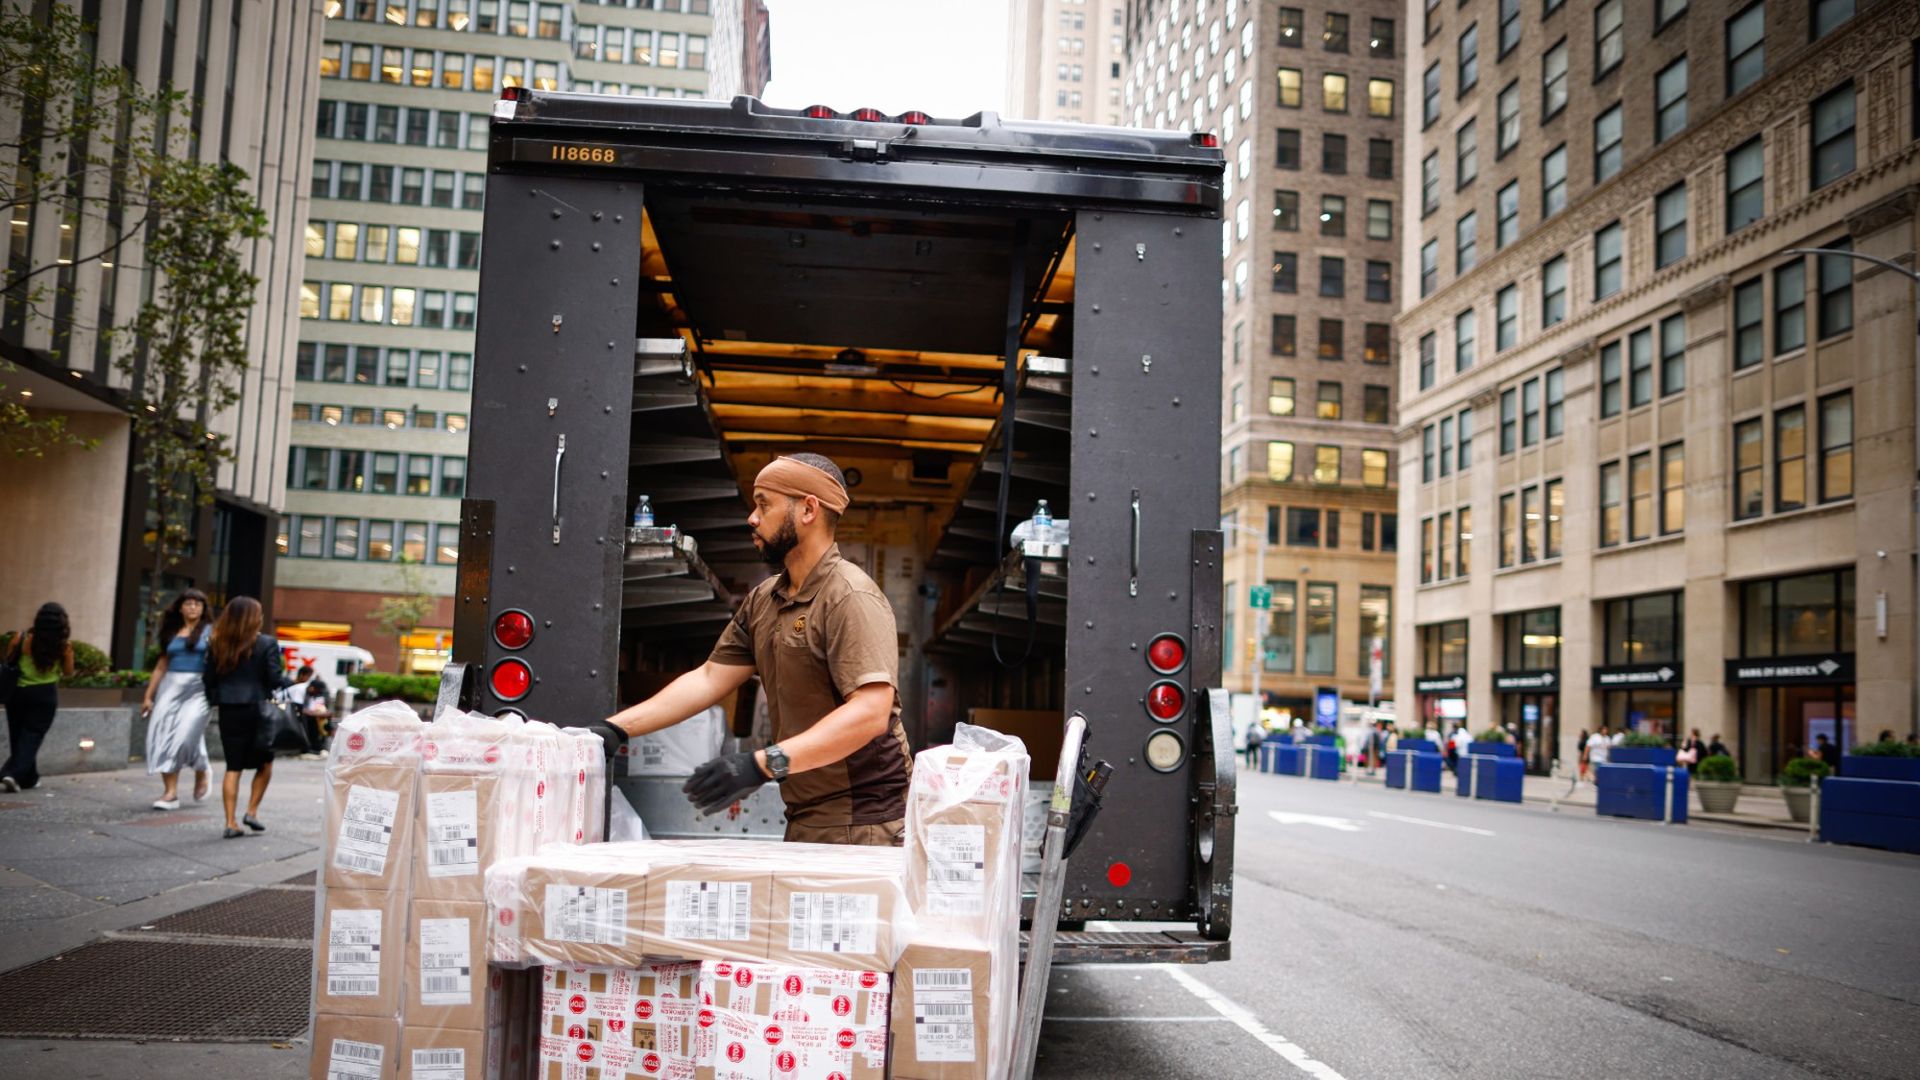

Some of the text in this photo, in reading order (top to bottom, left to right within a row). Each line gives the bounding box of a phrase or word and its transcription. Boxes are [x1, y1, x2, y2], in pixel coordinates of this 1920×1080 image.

[552, 145, 615, 163] 118668
[790, 976, 798, 994] STOP
[571, 1000, 585, 1008] STOP
[636, 1005, 652, 1013] STOP
[578, 1049, 593, 1057] STOP
[782, 1053, 790, 1071] STOP
